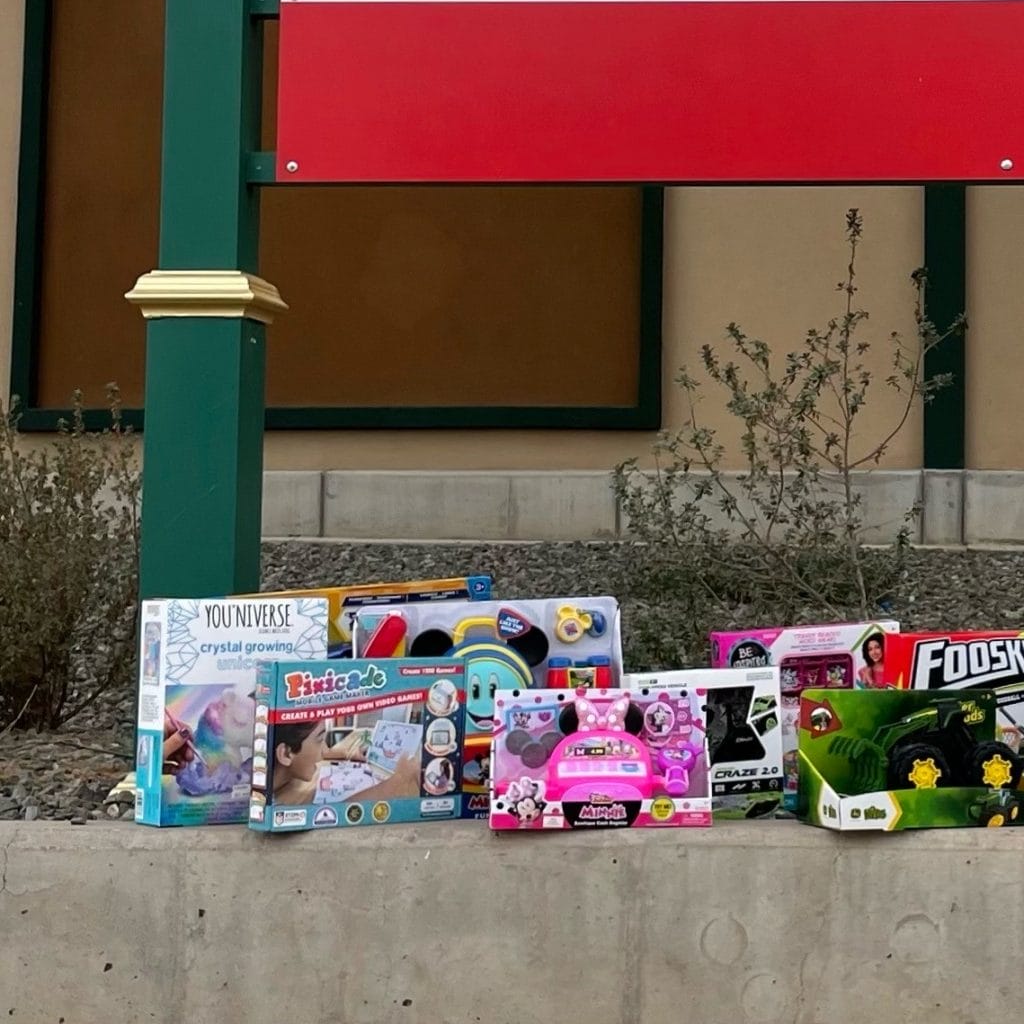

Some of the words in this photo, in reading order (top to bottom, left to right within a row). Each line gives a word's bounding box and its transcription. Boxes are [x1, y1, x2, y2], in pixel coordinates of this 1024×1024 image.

[201, 640, 242, 656] crystal
[245, 641, 293, 655] growing
[738, 647, 753, 658] BE
[287, 665, 386, 700] Pixicade
[281, 711, 309, 721] CREATE
[316, 707, 336, 717] PLAY
[357, 702, 374, 712] OWN
[375, 698, 396, 708] VIDEO
[714, 767, 758, 779] CRAZE
[761, 766, 779, 775] 2.0
